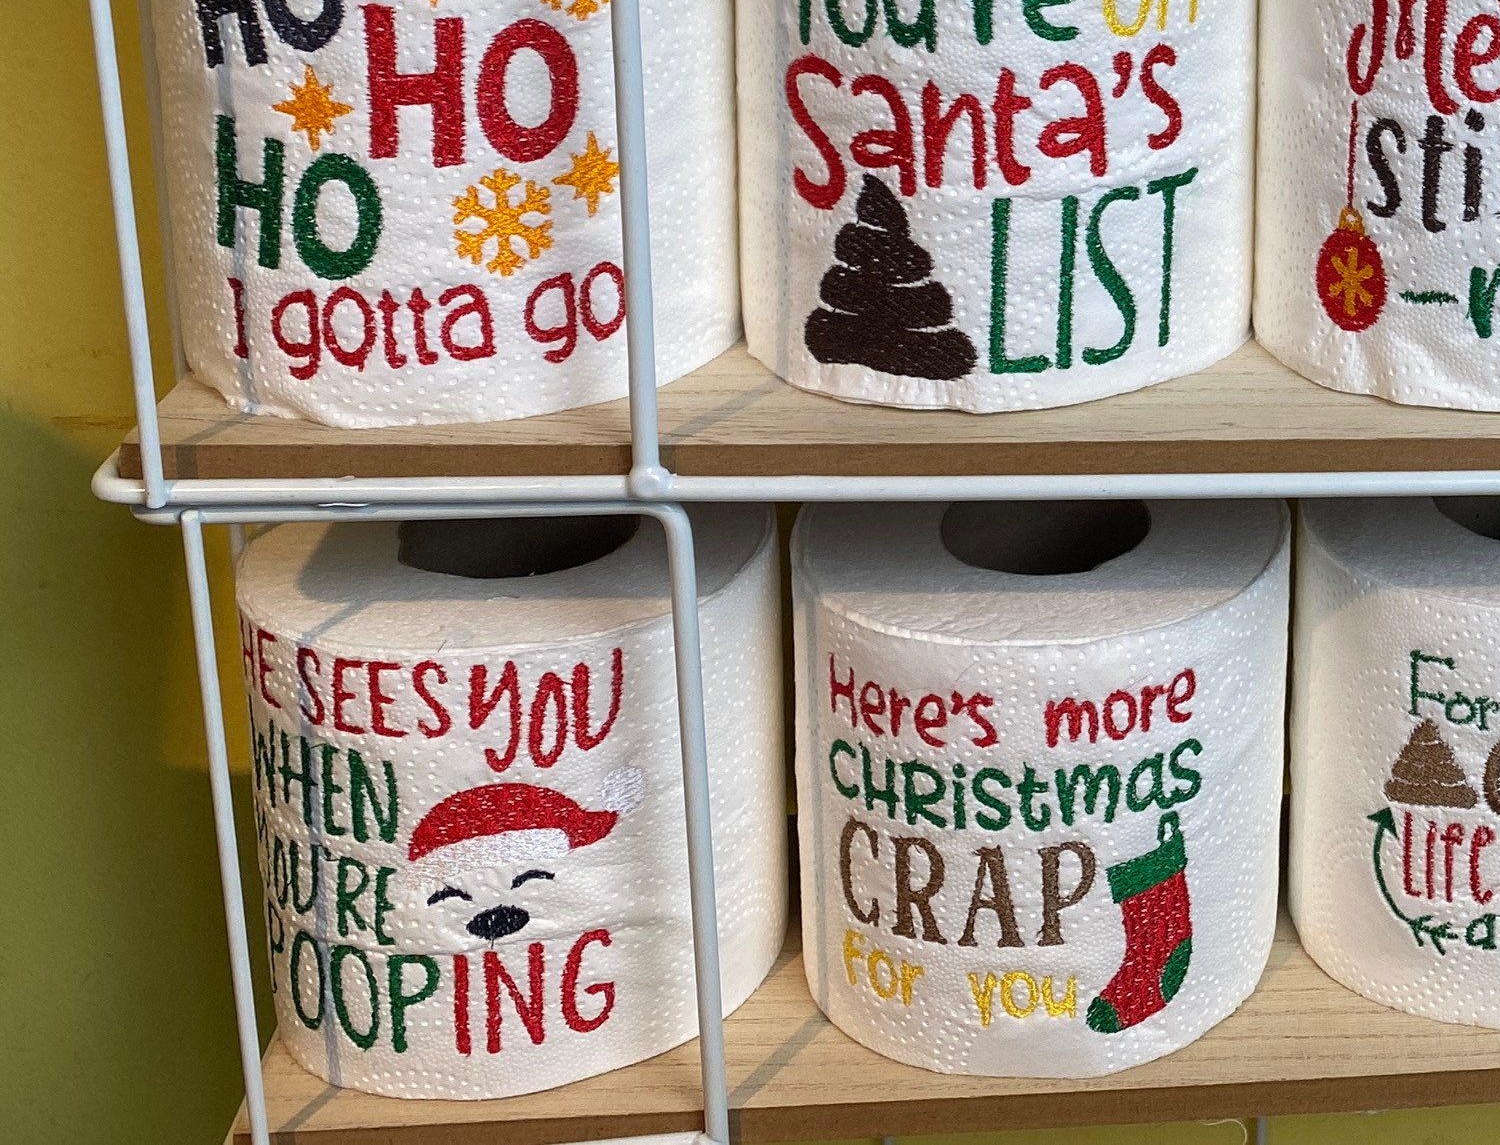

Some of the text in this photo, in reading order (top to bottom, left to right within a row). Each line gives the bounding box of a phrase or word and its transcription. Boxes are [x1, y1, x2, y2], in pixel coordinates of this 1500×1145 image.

[358, 3, 581, 168] HO
[785, 42, 1184, 211] Santa's
[214, 114, 385, 282] HO
[988, 167, 1200, 376] LIST
[227, 260, 628, 381] I gotta go
[249, 693, 400, 845] WHEN
[297, 646, 452, 740] SEES
[827, 652, 1197, 750] Here's more
[839, 817, 1098, 949] CRAP
[267, 899, 615, 1056] POOPING
[966, 969, 1077, 1029] you
